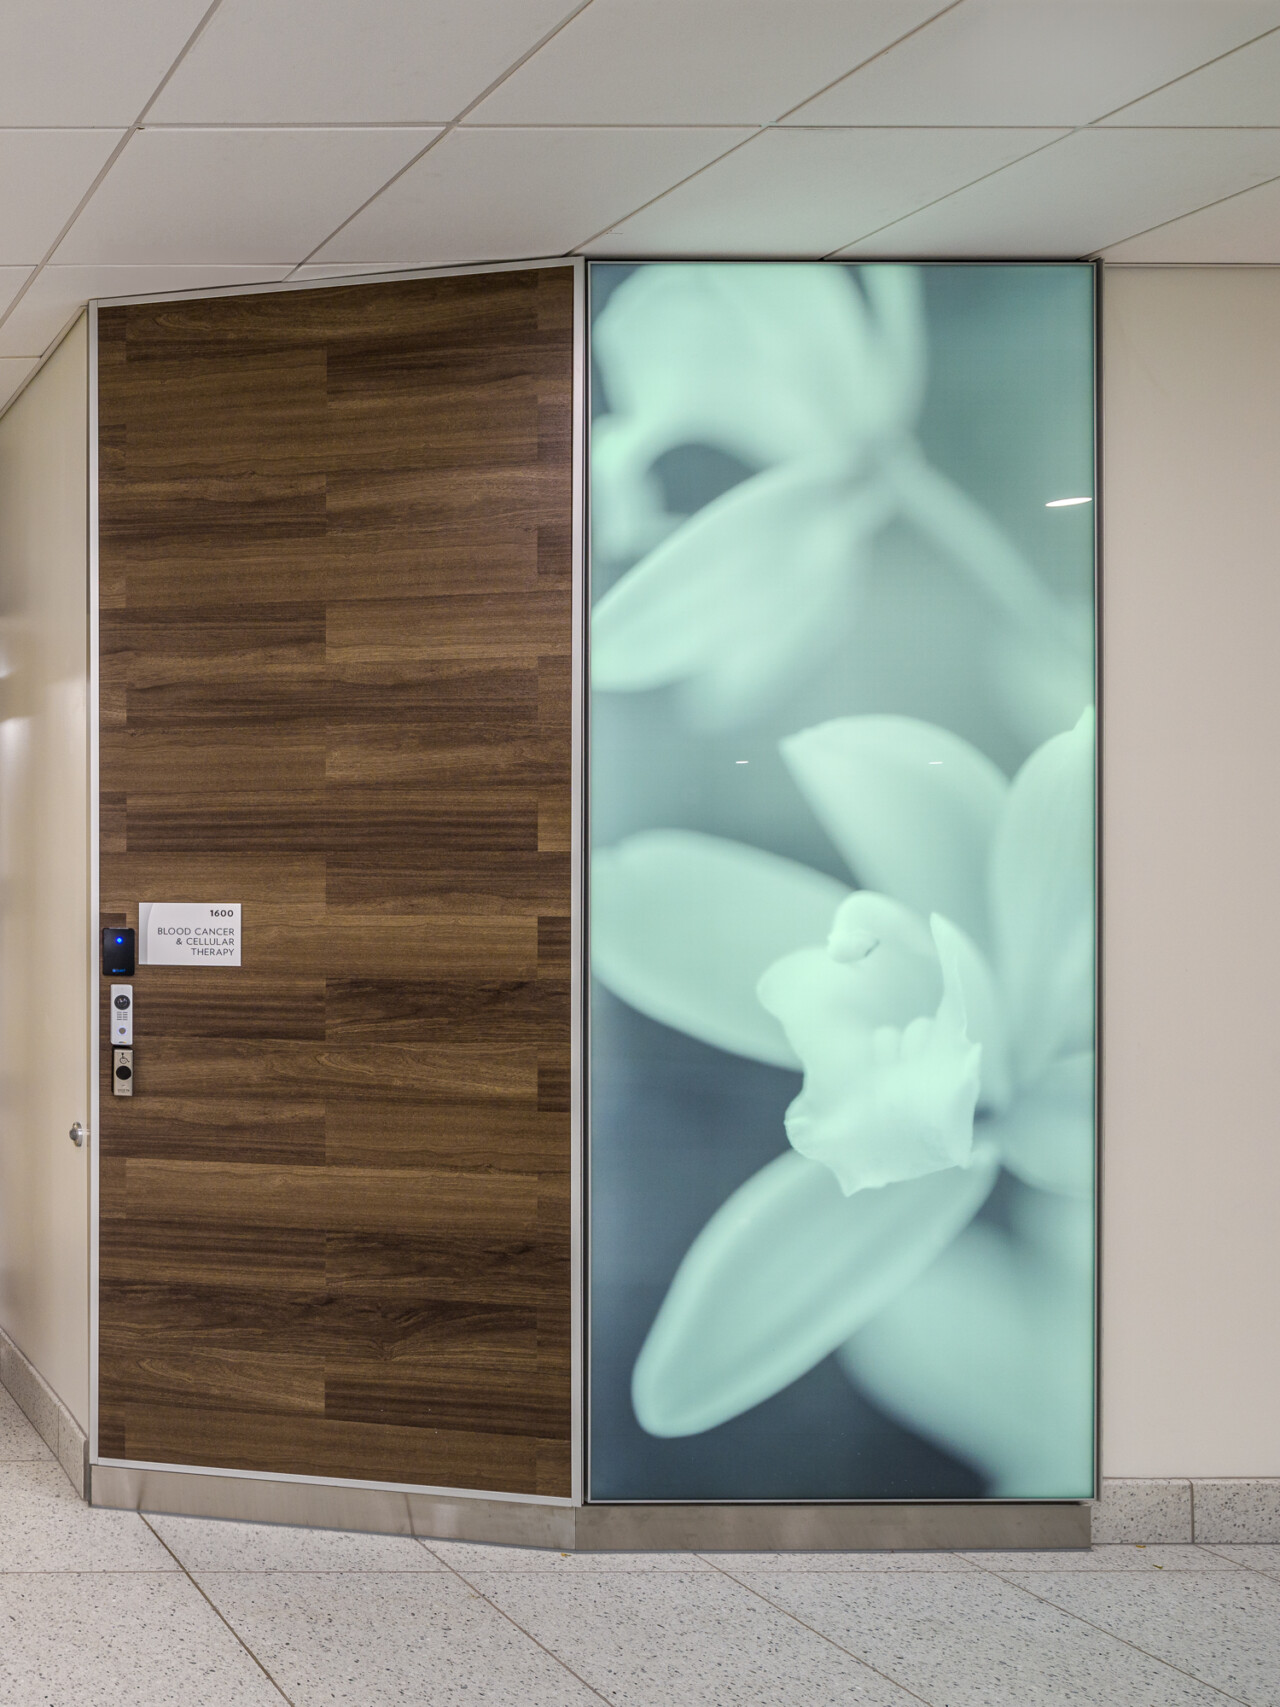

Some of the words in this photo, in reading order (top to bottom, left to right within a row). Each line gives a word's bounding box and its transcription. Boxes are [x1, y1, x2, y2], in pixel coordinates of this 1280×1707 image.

[157, 927, 191, 935] BLOOD
[194, 927, 235, 936] CANCER
[176, 937, 182, 945] &
[186, 937, 235, 945] CELLULAR
[191, 947, 235, 956] THERAPY
